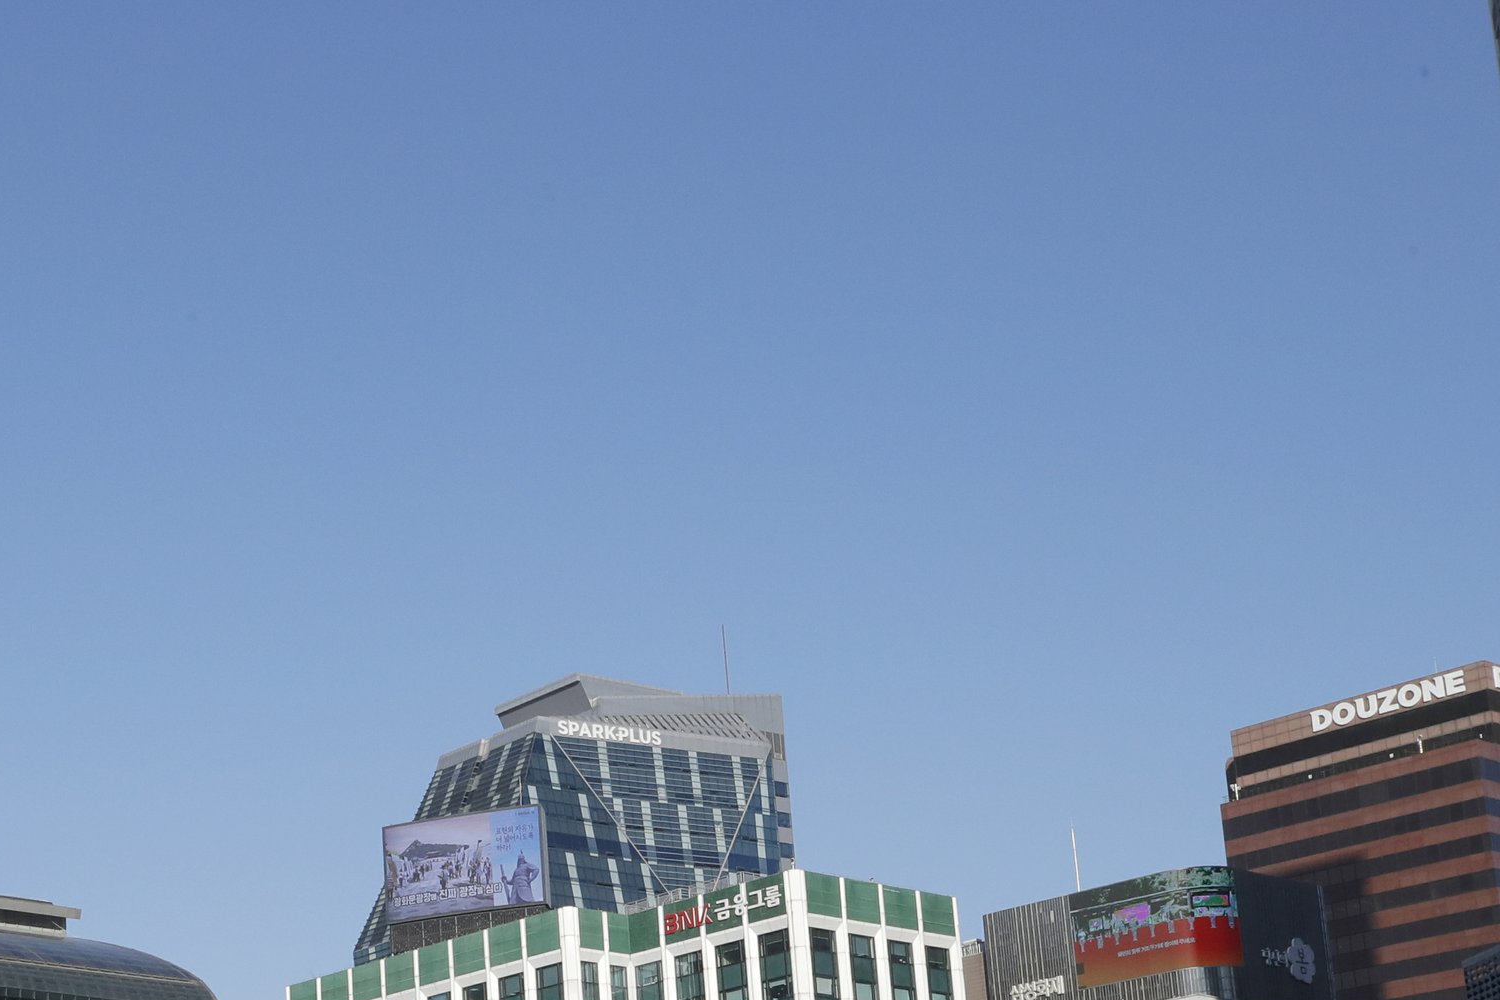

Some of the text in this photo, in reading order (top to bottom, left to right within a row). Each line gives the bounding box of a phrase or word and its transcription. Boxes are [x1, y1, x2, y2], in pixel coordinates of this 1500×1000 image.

[1309, 670, 1466, 732] DOUZONE
[664, 885, 782, 935] BNK 금융그룹
